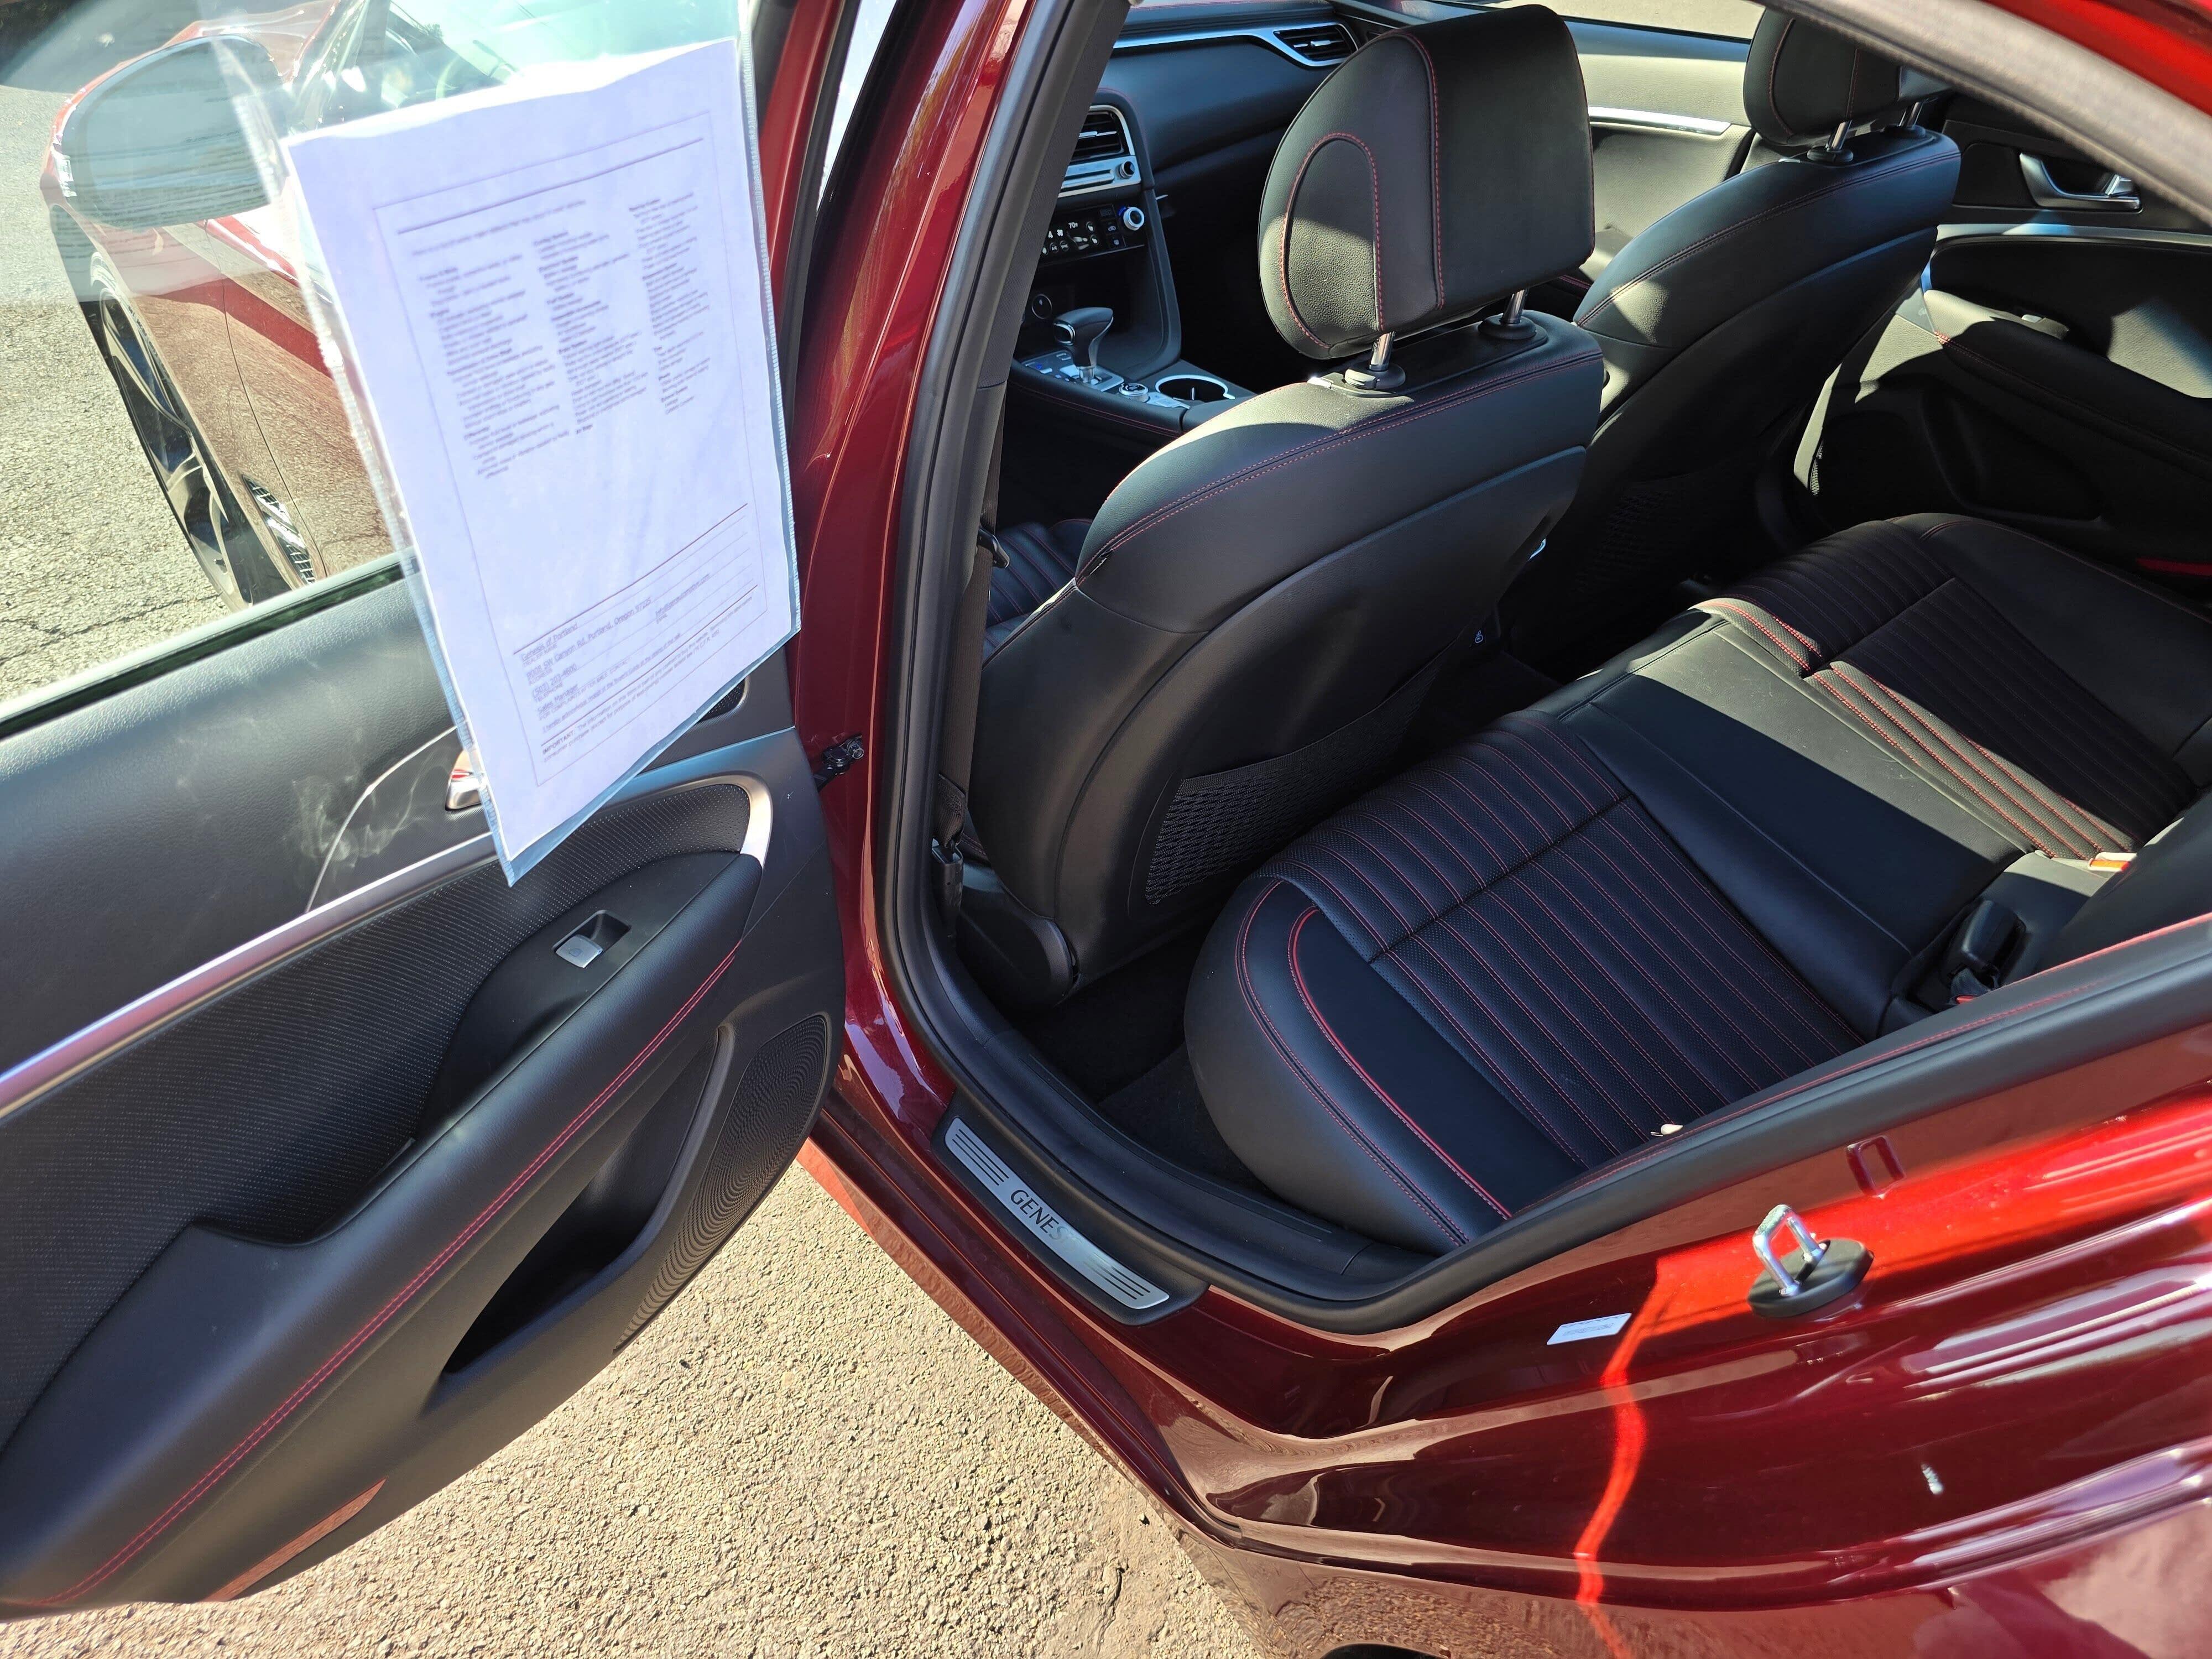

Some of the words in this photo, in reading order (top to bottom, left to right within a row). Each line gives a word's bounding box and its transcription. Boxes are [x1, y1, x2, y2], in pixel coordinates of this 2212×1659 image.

[521, 643, 545, 661] Genesis
[553, 622, 578, 641] Portland
[544, 658, 554, 669] SW
[555, 644, 576, 662] Canyon
[614, 607, 635, 625] Oregon
[538, 700, 553, 713] Sales
[555, 684, 578, 703] Manager
[1010, 1190, 1082, 1251] GENES
